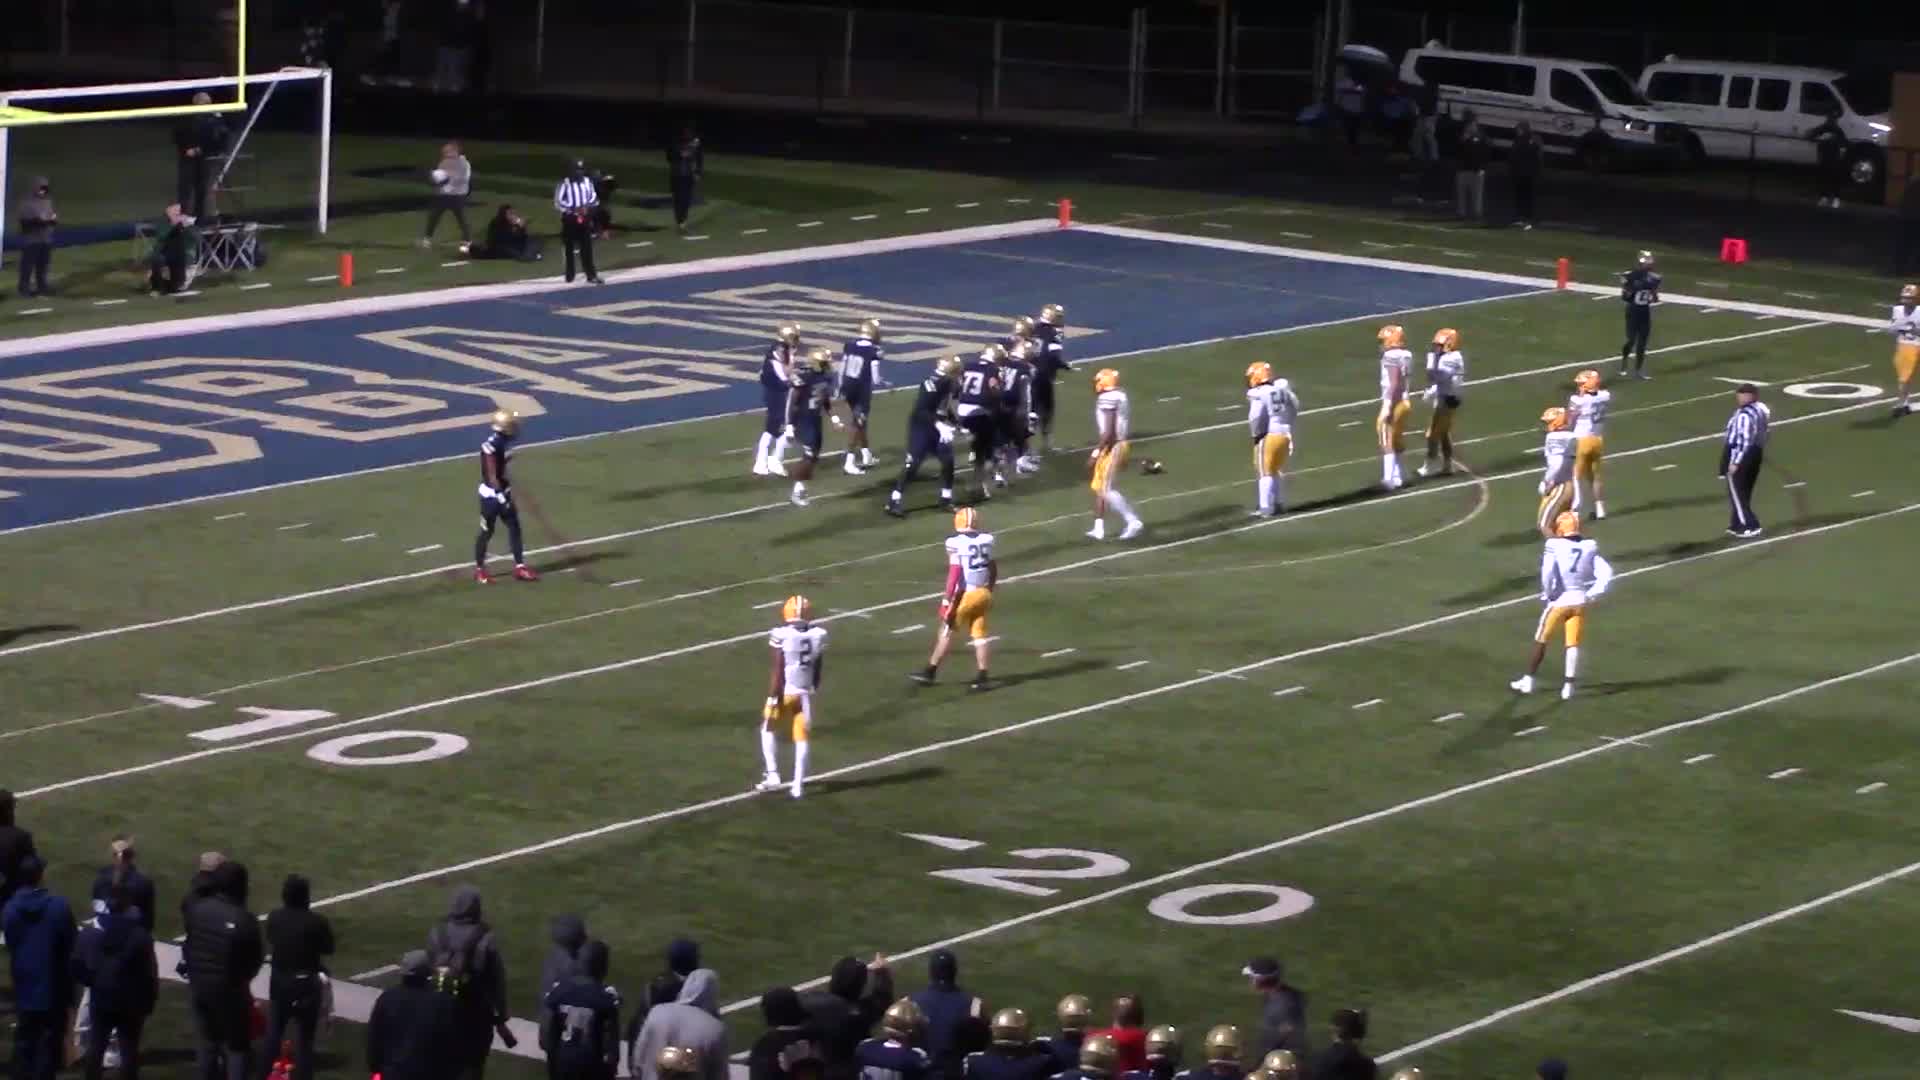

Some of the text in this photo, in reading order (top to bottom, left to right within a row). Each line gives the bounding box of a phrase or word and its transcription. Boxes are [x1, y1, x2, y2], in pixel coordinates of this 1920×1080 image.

[963, 371, 985, 395] 73
[968, 544, 990, 570] 25
[1569, 547, 1583, 573] 7
[798, 638, 814, 667] 2
